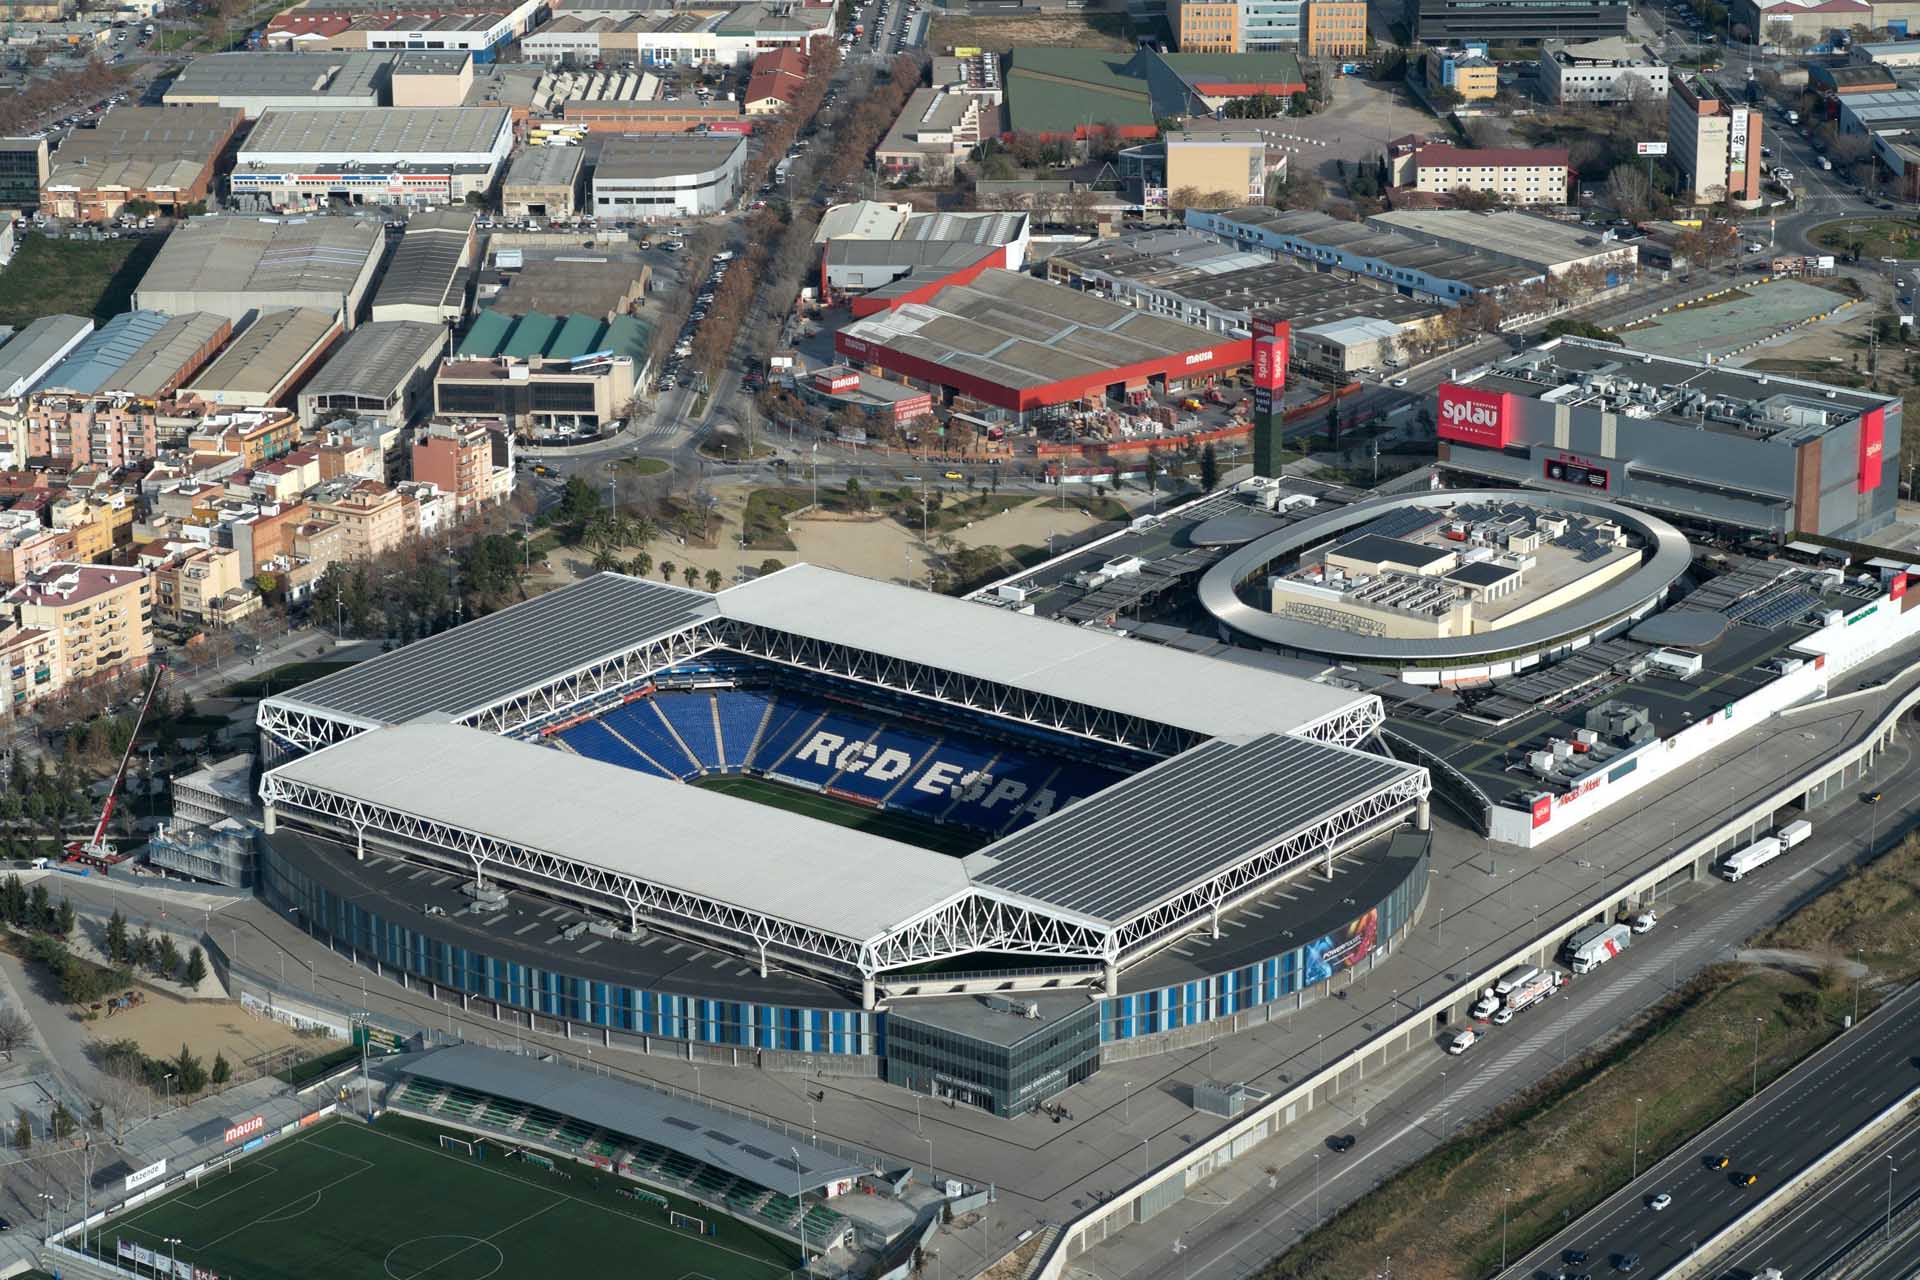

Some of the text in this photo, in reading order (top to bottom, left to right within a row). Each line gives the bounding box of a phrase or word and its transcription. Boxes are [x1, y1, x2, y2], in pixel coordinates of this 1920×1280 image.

[796, 731, 1080, 820] RCD ESPA
[225, 1116, 263, 1142] MAUSA
